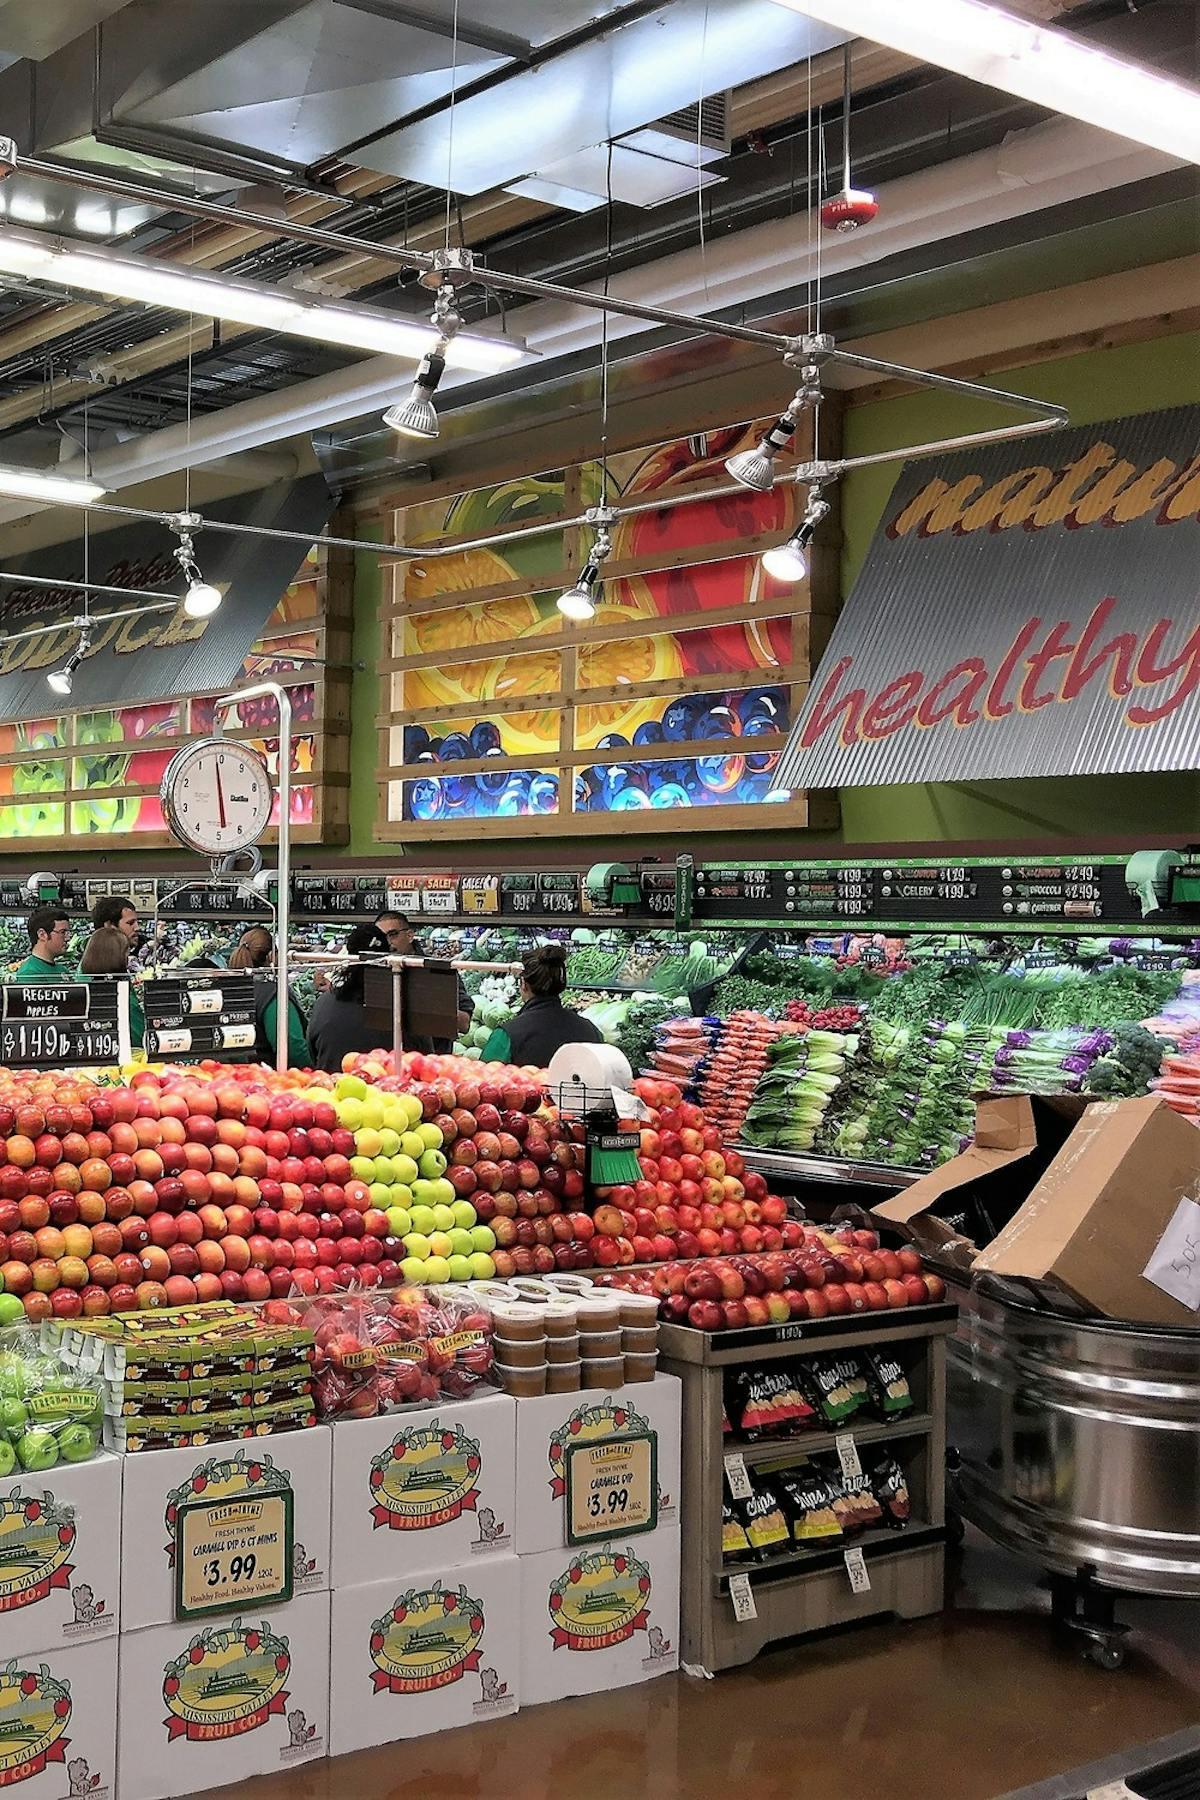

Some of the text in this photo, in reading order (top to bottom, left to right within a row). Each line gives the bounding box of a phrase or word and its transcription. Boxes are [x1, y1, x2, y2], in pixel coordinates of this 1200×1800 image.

[800, 596, 1200, 753] healthy
[198, 761, 202, 770] 1
[219, 754, 225, 764] 0
[239, 763, 245, 773] 9
[183, 778, 189, 788] 2
[251, 782, 257, 792] 8
[182, 803, 188, 813] 3
[251, 807, 257, 817] 7
[195, 822, 200, 832] 4
[237, 825, 243, 835] 6
[216, 831, 222, 841] 5
[392, 879, 416, 889] SALE!
[427, 879, 451, 889] SALE!
[903, 885, 934, 896] CELERY
[22, 988, 69, 1001] REGENT
[26, 1004, 59, 1017] APPLES
[385, 1486, 467, 1516] MISSISSIPPI VALLEY
[587, 1488, 628, 1517] $3.99
[400, 1508, 454, 1528] FRUIT CO.
[215, 1525, 256, 1538] FRESH THYME
[193, 1541, 225, 1557] CARAMEL
[227, 1539, 239, 1551] DIP
[240, 1539, 246, 1548] 6
[247, 1536, 256, 1547] CT
[18, 1558, 57, 1590] VALLEY
[203, 1553, 256, 1586] $3.99
[15, 1588, 42, 1606] CO.
[190, 1592, 214, 1604] Healthy
[231, 1586, 255, 1596] Healthy
[563, 1606, 640, 1636] MISSISSIPPI VALLEY
[577, 1629, 628, 1650] FRUIT CO.
[385, 1648, 471, 1678] MISSISSIPPI VALLEY
[400, 1670, 457, 1691] FRUIT CO.
[180, 1686, 275, 1723] MISSISSIPPI VALLEY
[199, 1713, 261, 1739] FRUIT CO.
[13, 1734, 52, 1764] VALLEY
[11, 1763, 37, 1780] CO.
